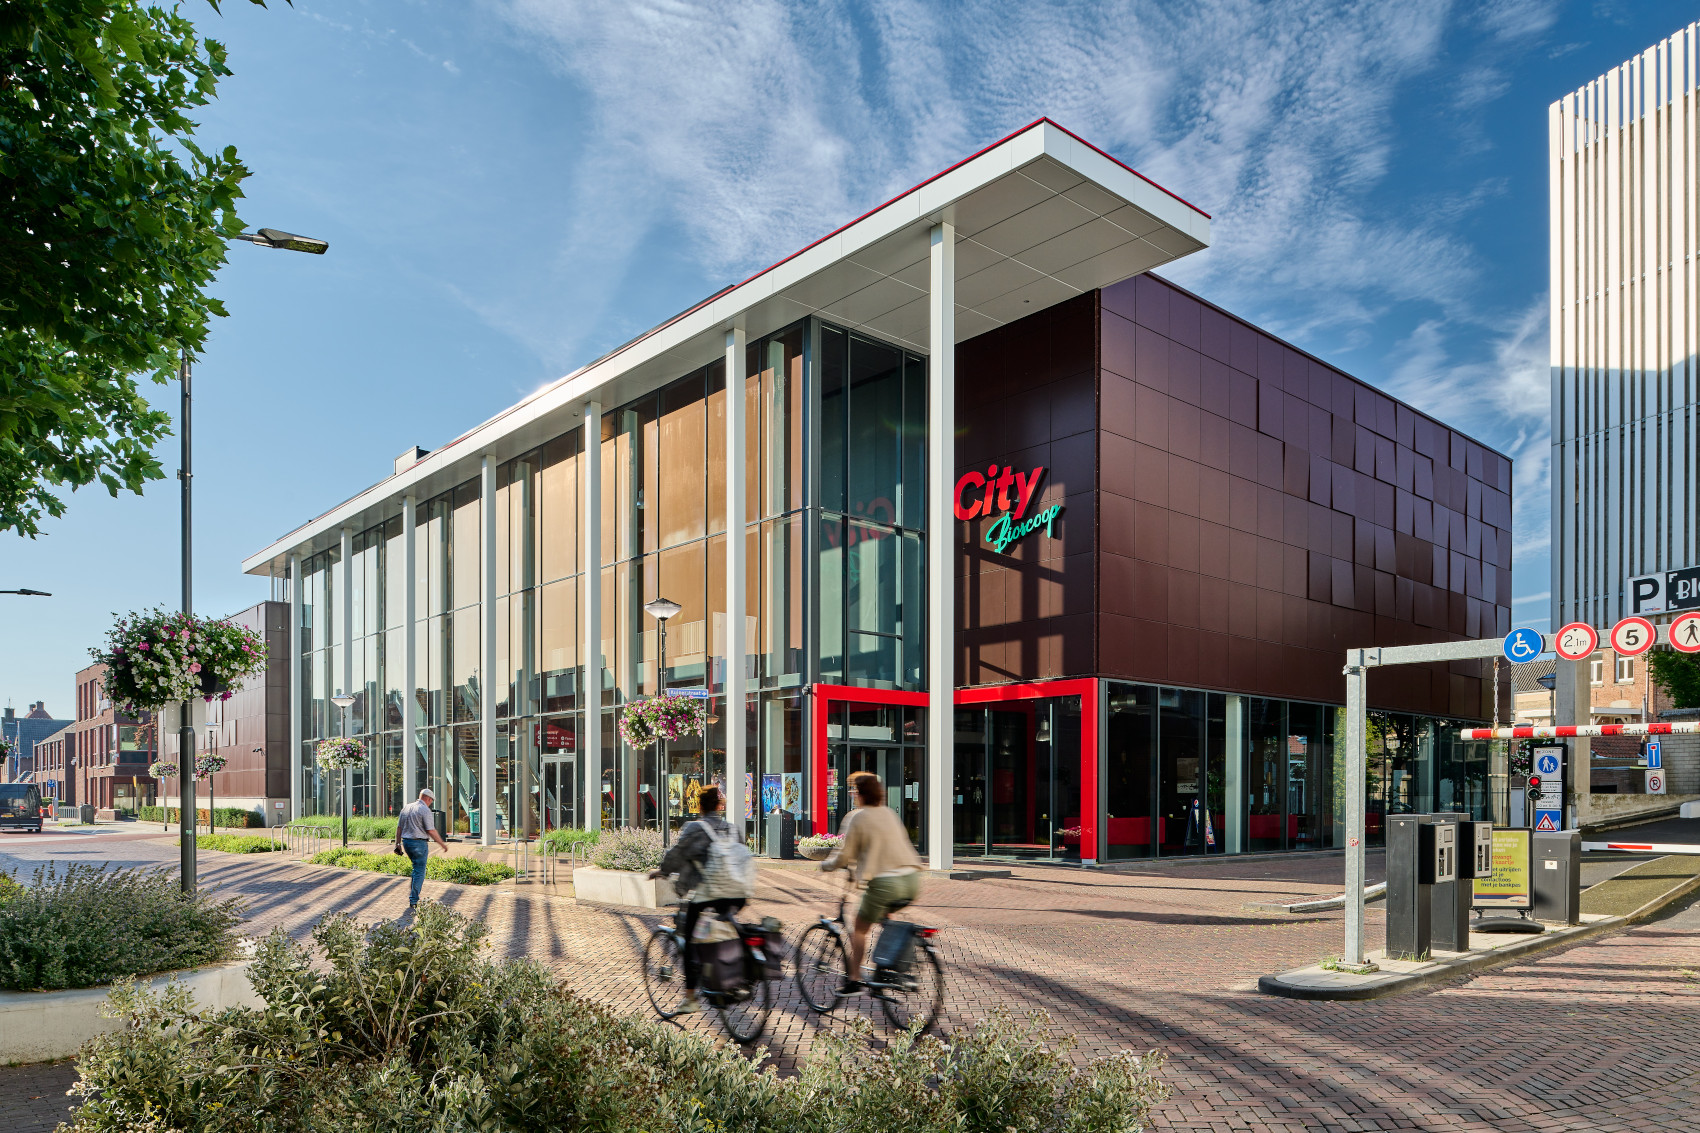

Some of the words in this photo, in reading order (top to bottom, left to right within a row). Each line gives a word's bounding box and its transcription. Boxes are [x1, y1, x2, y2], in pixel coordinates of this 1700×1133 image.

[953, 464, 1044, 521] City
[985, 504, 1061, 554] Bioscoop
[1633, 578, 1660, 613] P
[1676, 577, 1700, 600] BI
[1625, 629, 1640, 646] 5
